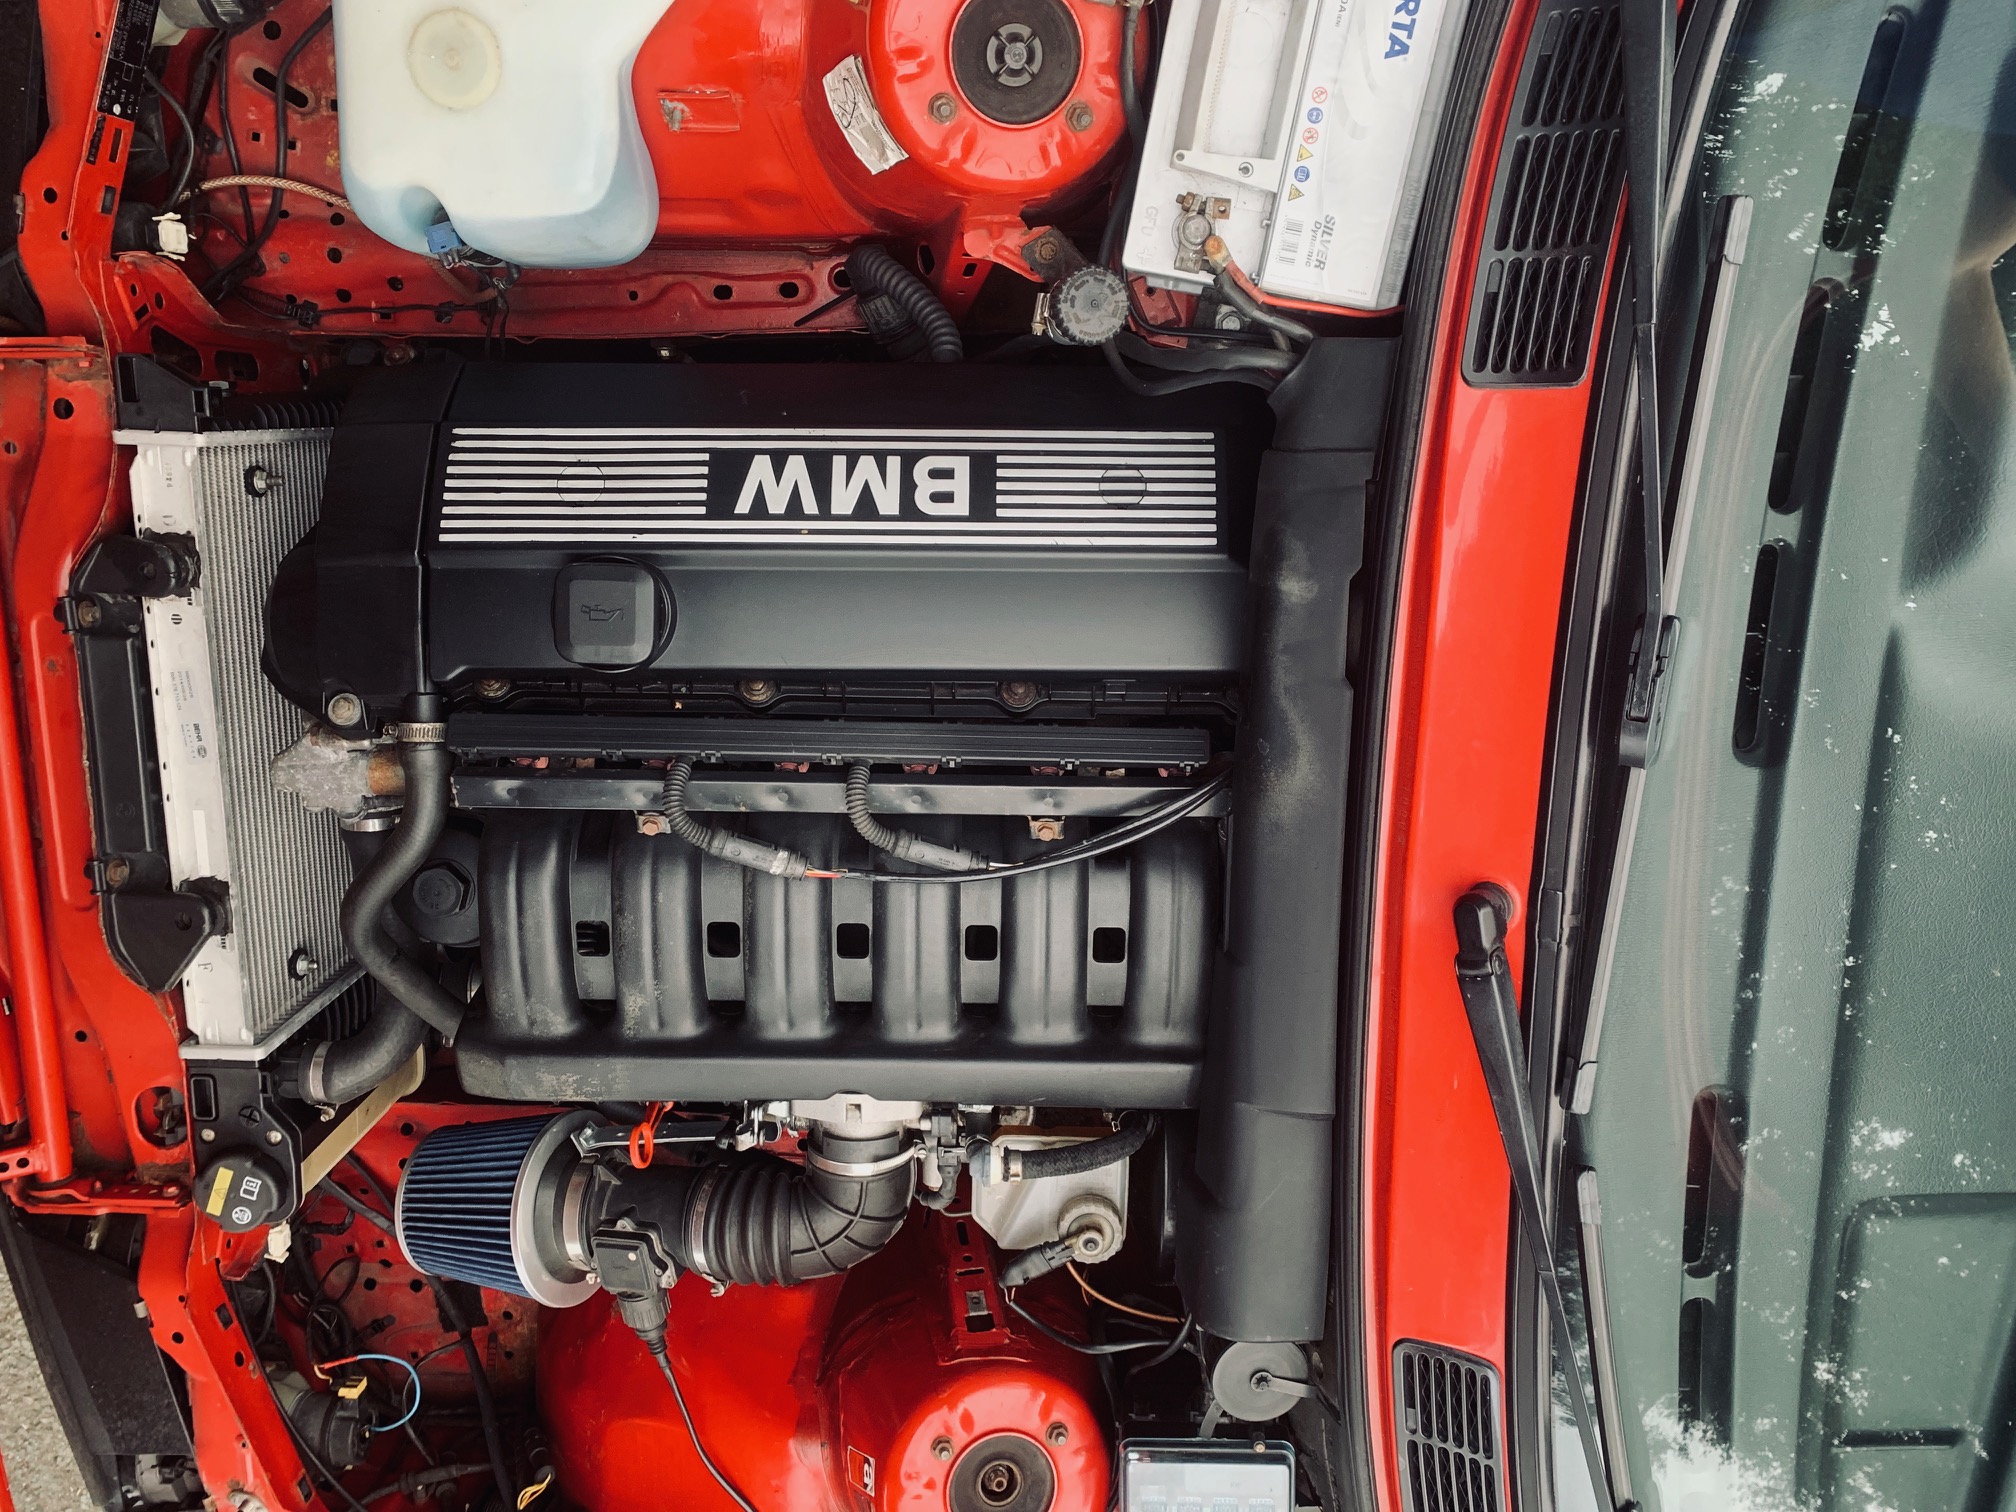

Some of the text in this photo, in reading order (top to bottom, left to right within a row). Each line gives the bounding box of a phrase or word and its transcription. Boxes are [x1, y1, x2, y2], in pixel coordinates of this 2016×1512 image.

[1305, 219, 1323, 268] Dynamic
[1313, 214, 1337, 270] SILVER
[733, 454, 971, 516] BMW
[193, 723, 203, 742] BEHR
